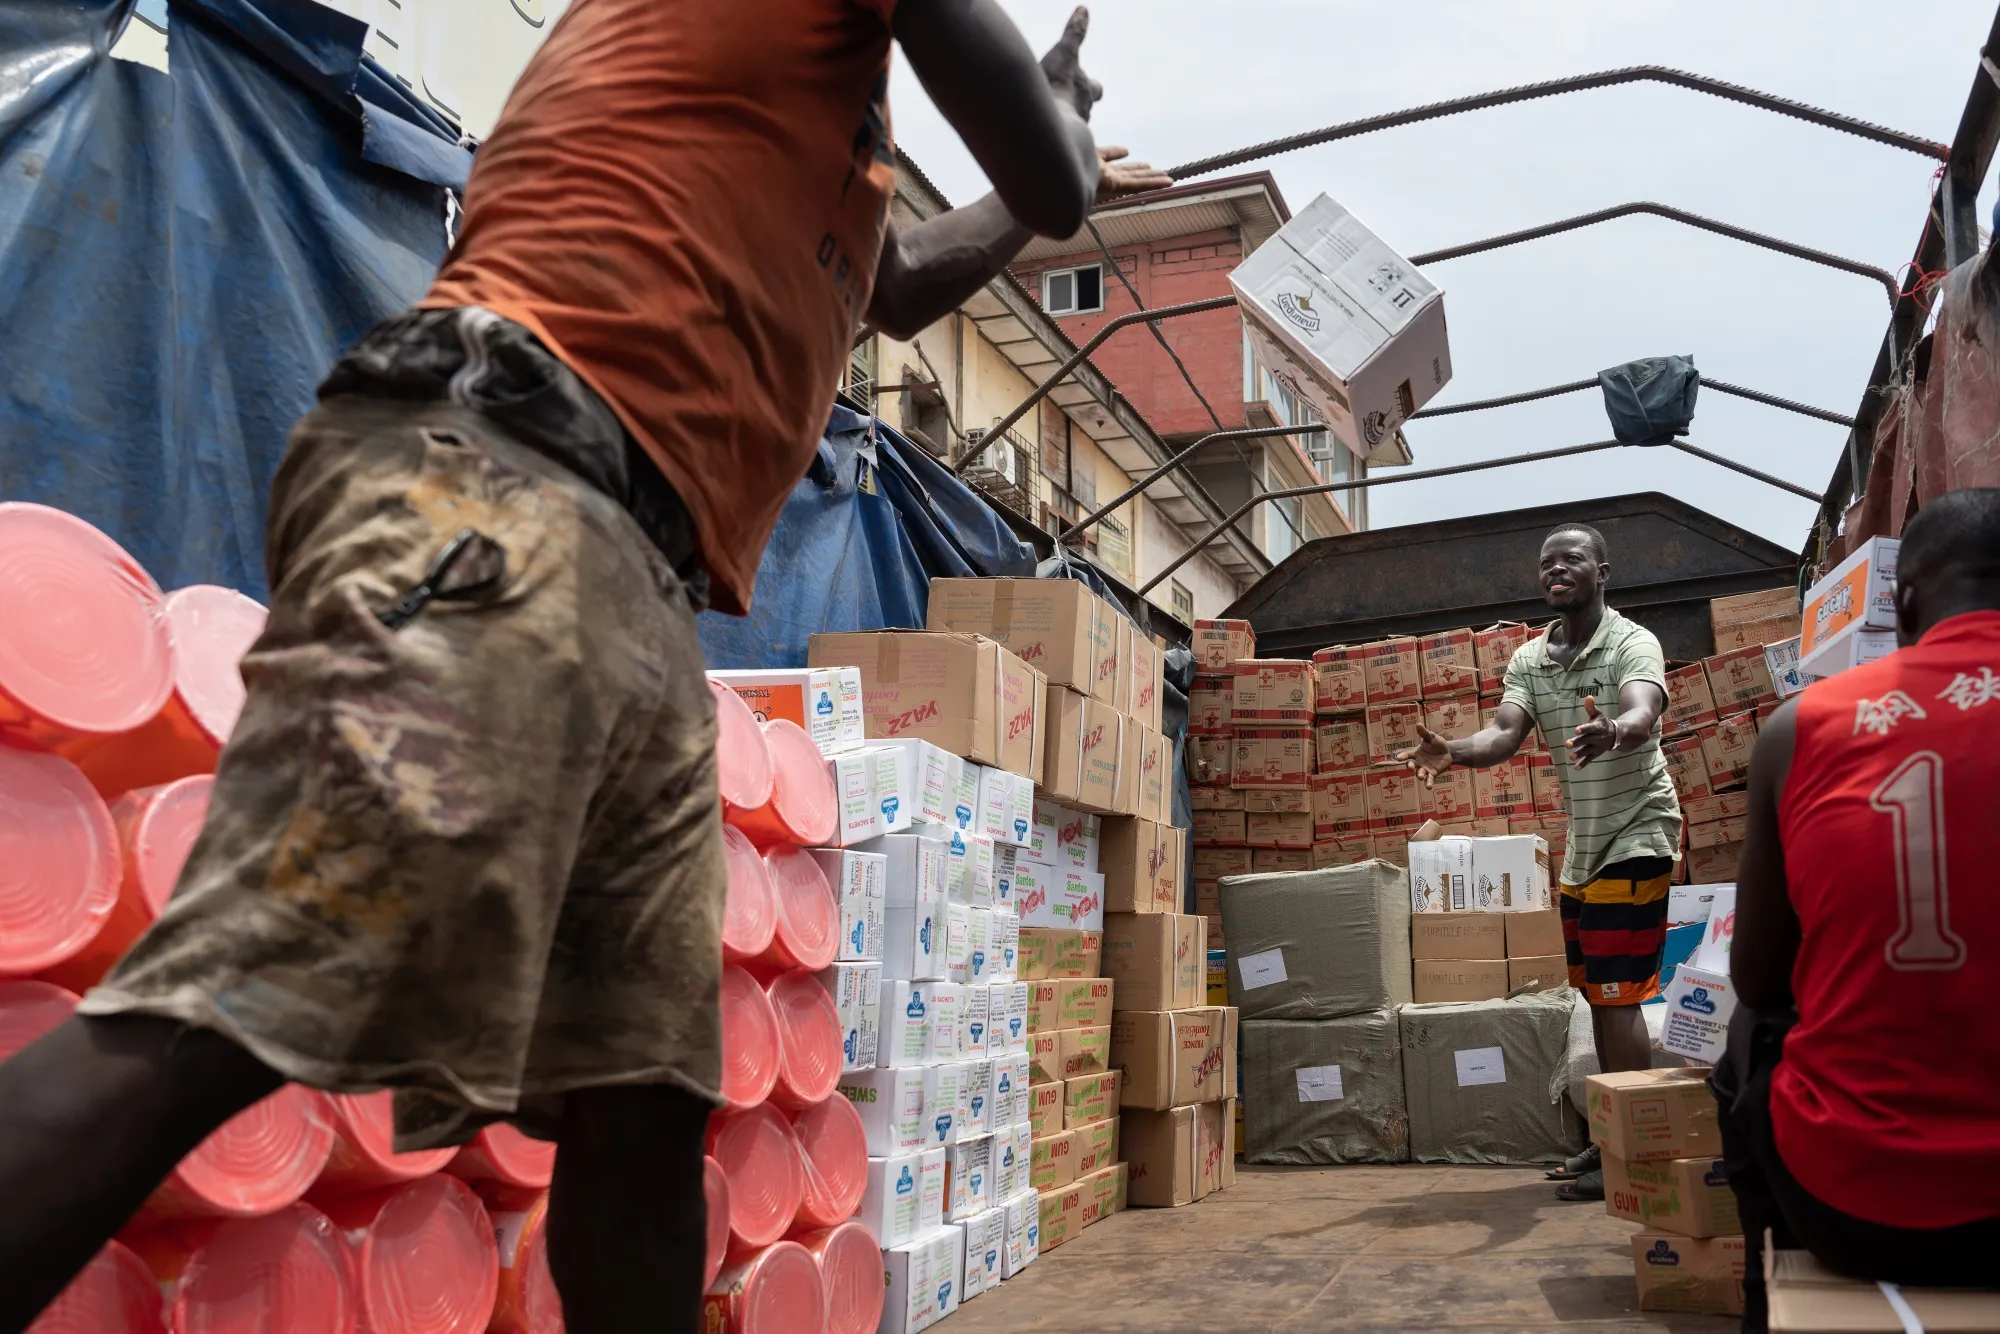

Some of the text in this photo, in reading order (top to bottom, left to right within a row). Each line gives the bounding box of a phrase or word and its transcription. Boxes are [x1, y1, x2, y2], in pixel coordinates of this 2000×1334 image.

[1281, 294, 1318, 330] mauripan
[1735, 631, 1746, 643] 4
[1015, 643, 1042, 662] YA
[888, 701, 938, 736] YAZZ
[1238, 709, 1299, 719] 100 100
[1008, 707, 1031, 739] YAZZ
[1240, 730, 1299, 739] 100 100
[1494, 804, 1515, 815] 100
[1332, 821, 1350, 833] 100
[1385, 815, 1404, 827] 100
[1031, 839, 1043, 851] San
[1067, 846, 1086, 860] Santos
[1870, 749, 1968, 971] 1
[1015, 873, 1036, 887] Santos
[1066, 880, 1088, 894] Santos
[1415, 878, 1426, 909] mauripan
[1052, 903, 1072, 920] SWEETS
[1082, 936, 1098, 950] GUM
[1036, 987, 1053, 1002] GUM
[1091, 984, 1108, 998] GUM
[1670, 1018, 1721, 1035] AFRIWARA GROUP
[1671, 1012, 1694, 1023] ROYAL
[1693, 1017, 1717, 1029] SWEET
[1035, 1038, 1053, 1055] GUM
[1066, 1057, 1084, 1073] GUM
[1100, 1077, 1116, 1092] GUM
[838, 1085, 877, 1103] SWEE
[1038, 1090, 1057, 1106] GUM
[1085, 1103, 1105, 1116] Santos
[1031, 1118, 1044, 1130] San
[1051, 1140, 1070, 1158] GUM
[1636, 1149, 1671, 1158] SACHETS
[1080, 1153, 1096, 1171] GUM
[1128, 1165, 1148, 1181] YA
[1625, 1161, 1659, 1184] Santos
[1062, 1193, 1079, 1211] GUM
[1613, 1190, 1640, 1215] GUM
[1082, 1203, 1099, 1222] GUM
